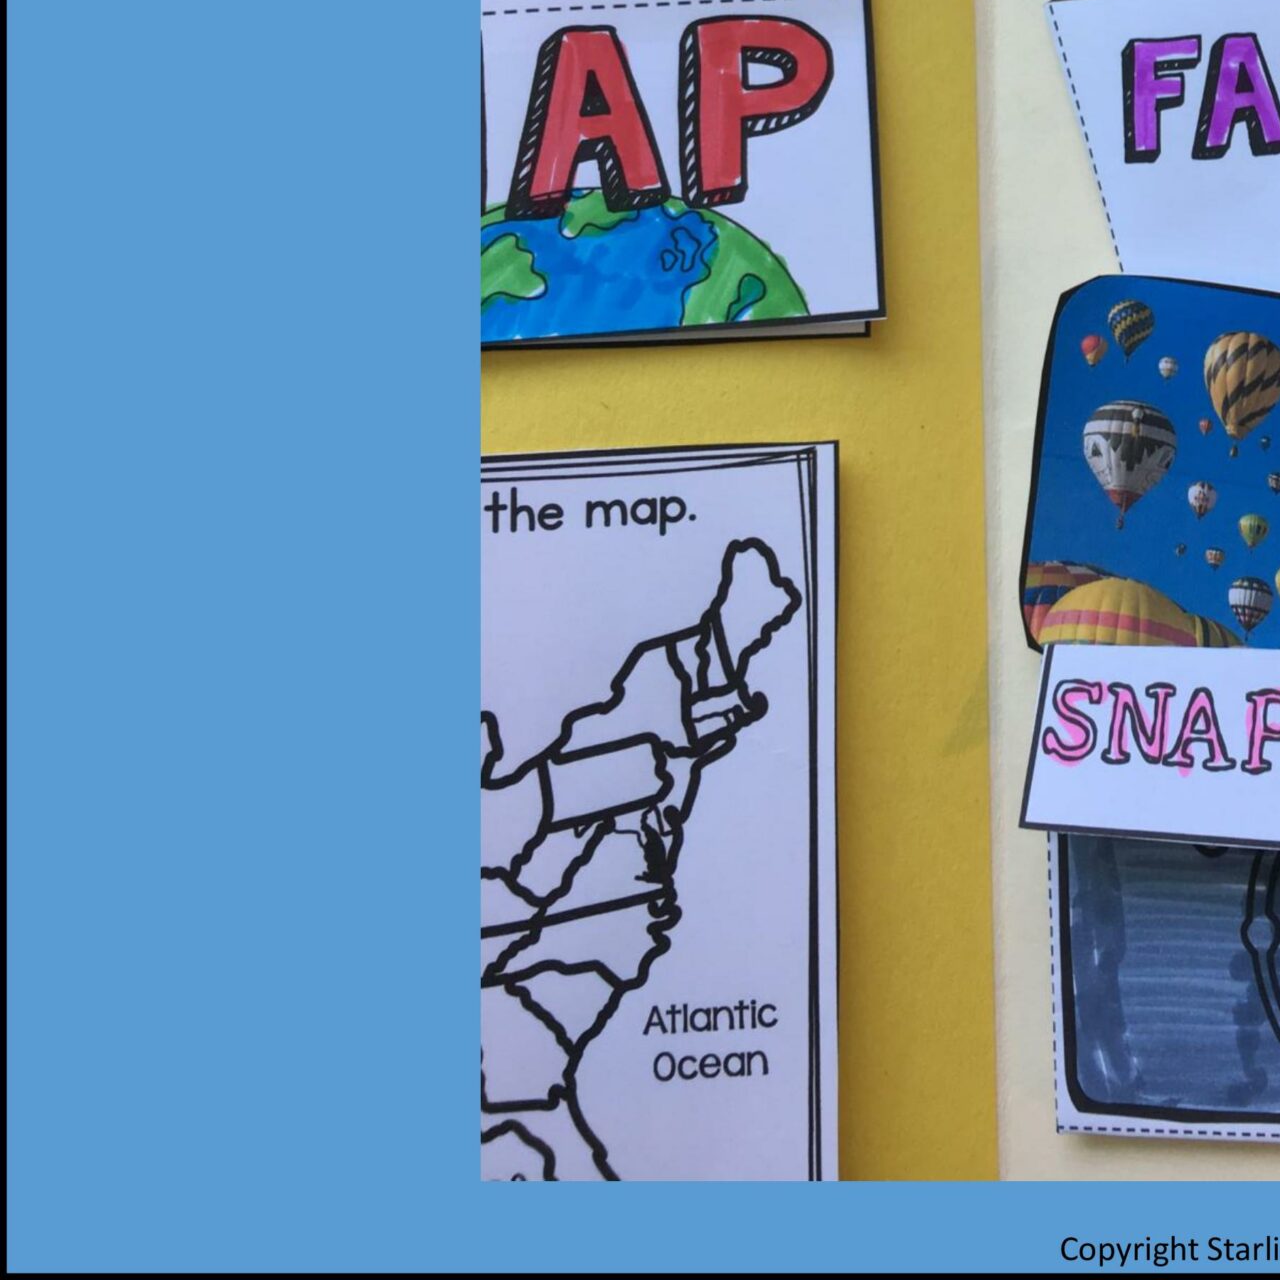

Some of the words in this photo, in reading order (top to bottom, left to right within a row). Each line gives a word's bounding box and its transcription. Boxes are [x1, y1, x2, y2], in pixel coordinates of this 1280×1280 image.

[481, 14, 834, 221] AP
[484, 486, 564, 534] the
[586, 496, 697, 537] map.
[642, 999, 779, 1036] Atlantic
[653, 1050, 769, 1082] Ocean
